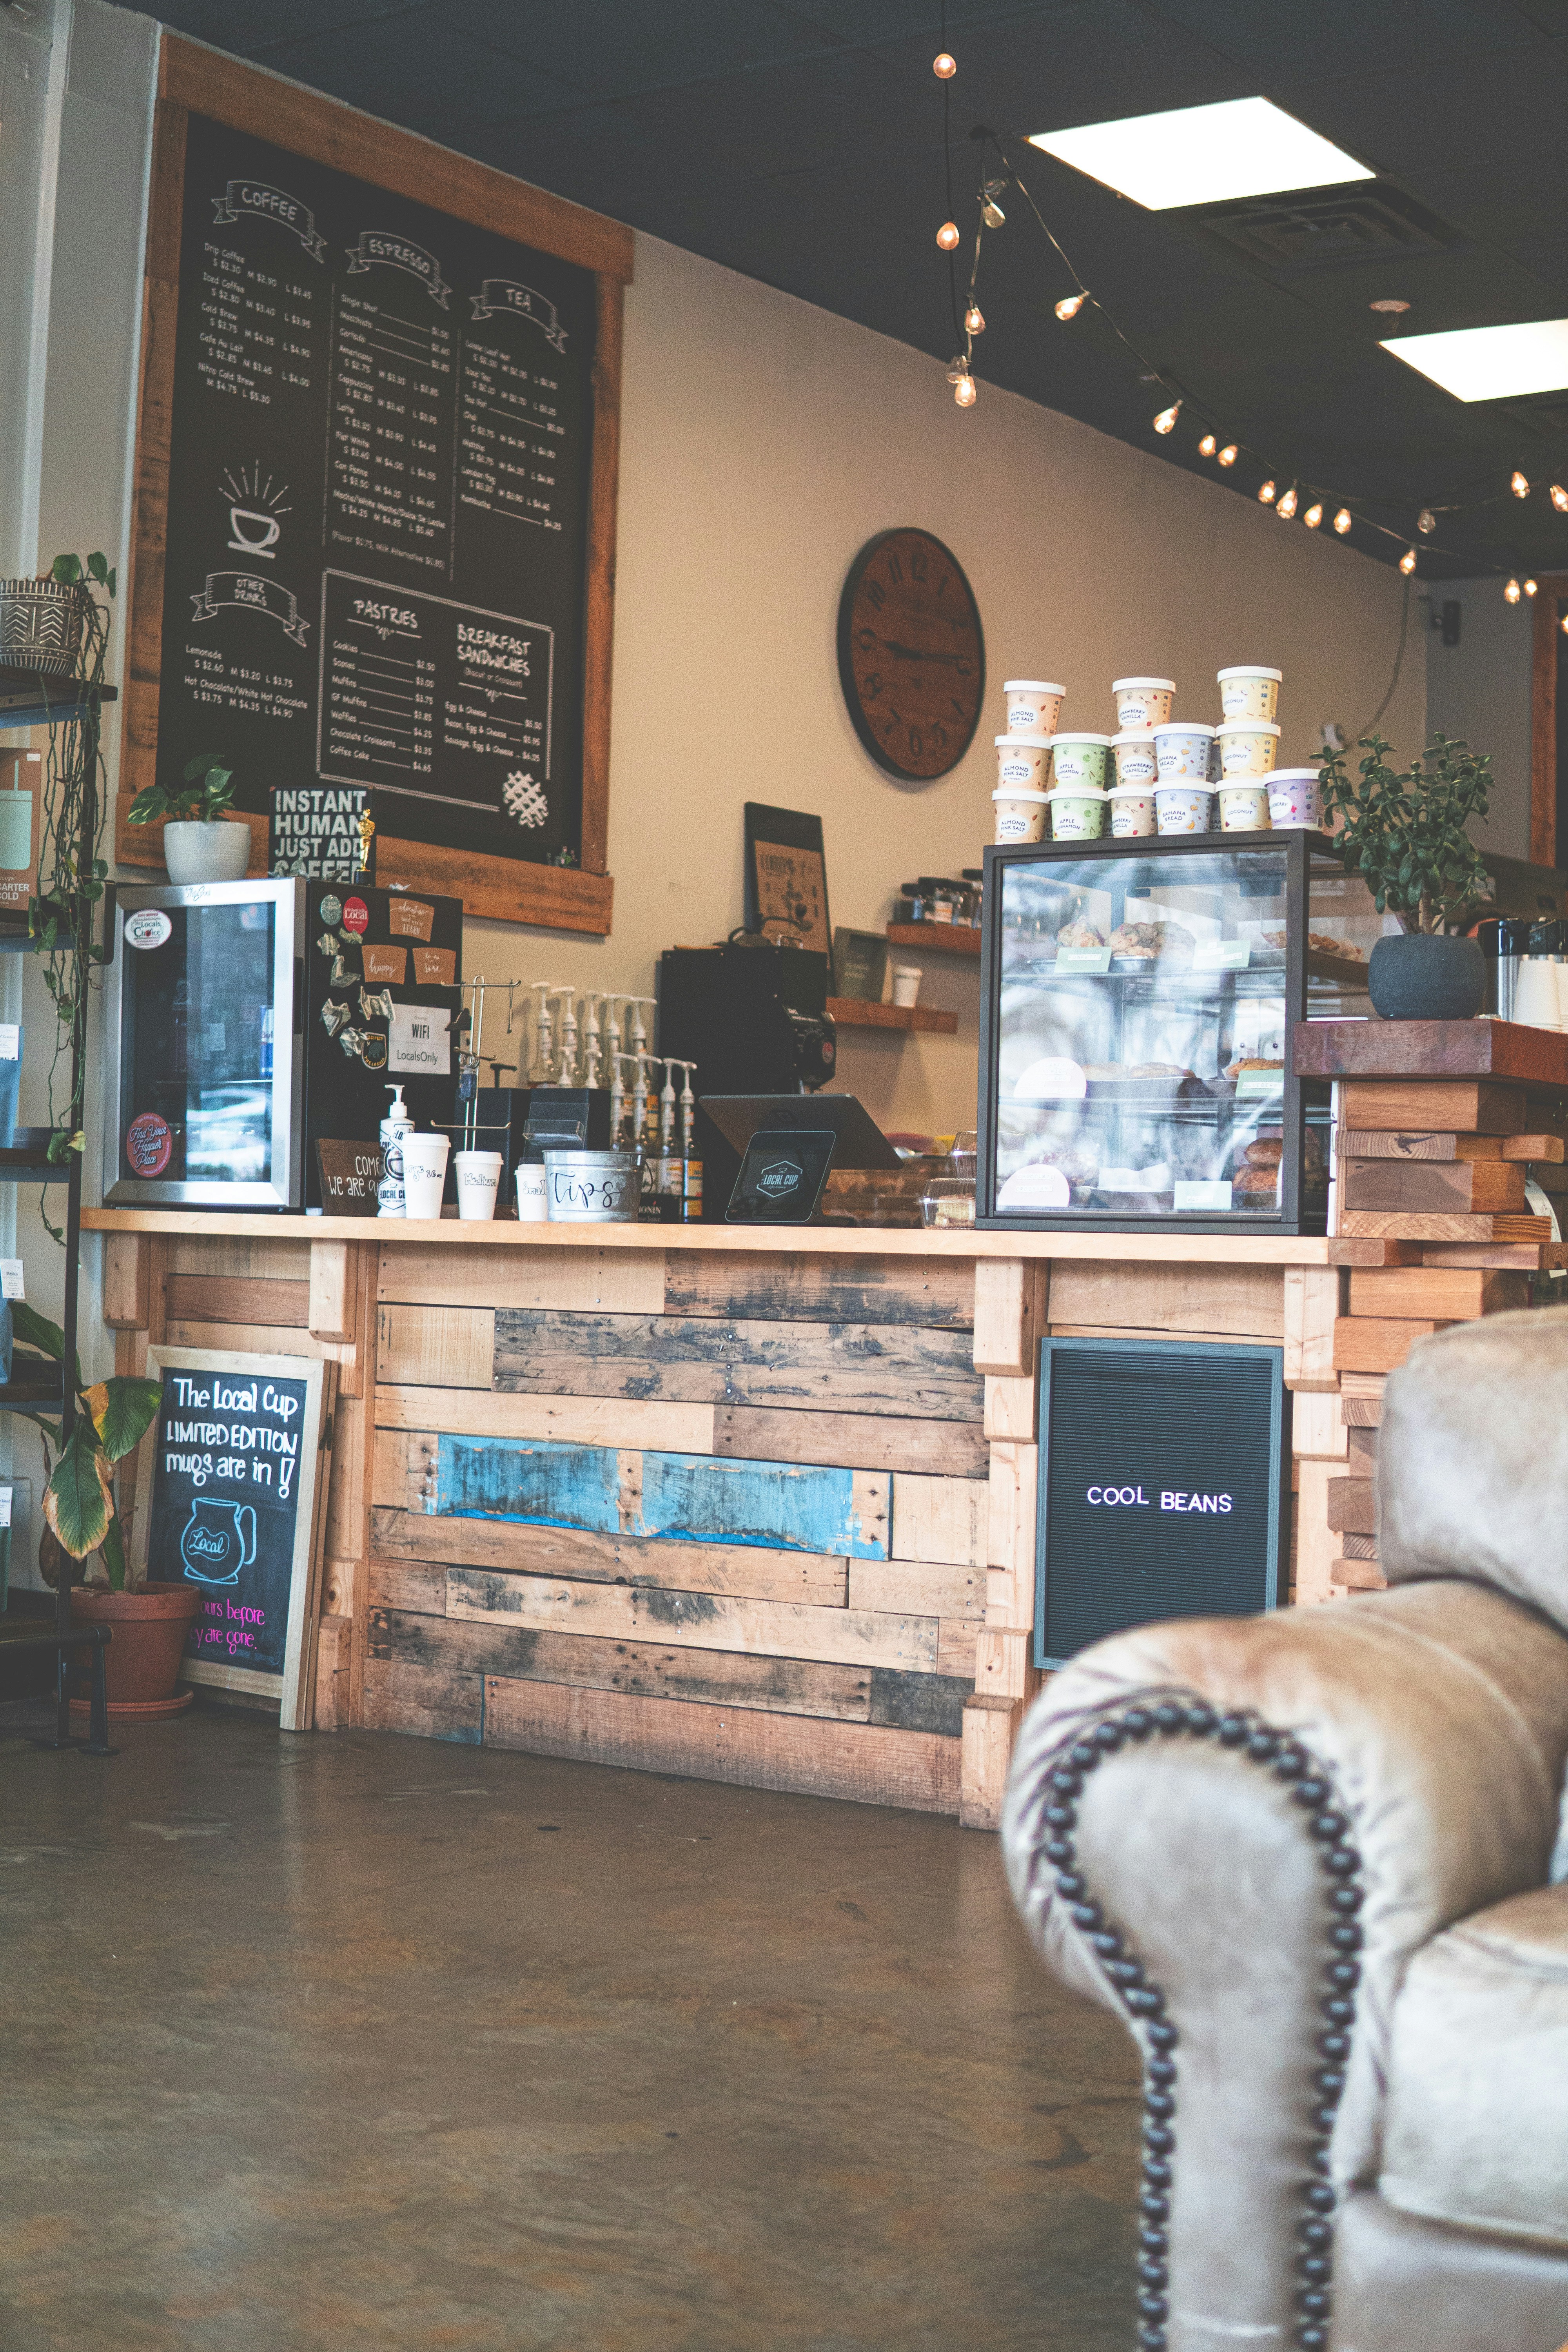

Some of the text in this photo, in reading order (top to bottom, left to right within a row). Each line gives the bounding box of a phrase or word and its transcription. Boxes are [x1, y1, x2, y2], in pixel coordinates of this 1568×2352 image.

[241, 187, 298, 221] COFFEE
[204, 242, 245, 264] Drip Coffee
[369, 239, 430, 274] ESPRESSO
[203, 272, 245, 294] Iced Coffee
[201, 302, 238, 321] Cold Brew
[198, 362, 255, 387] Nitro Cold Brew
[237, 578, 265, 594] OTHER
[235, 589, 267, 606] DRINKS
[353, 600, 418, 628] PASTRIES
[332, 640, 358, 653] Cookies
[457, 623, 532, 655] BREAKFAST
[185, 644, 222, 660] Lemonade
[457, 645, 531, 676] SANDWICHES
[194, 659, 200, 668] S
[230, 667, 238, 676] M
[265, 675, 271, 684] L
[332, 657, 356, 670] Scones
[331, 675, 357, 688] Muffins
[184, 675, 198, 686] Hot
[260, 692, 273, 701] Hot
[275, 695, 308, 710] Chocolate
[341, 695, 367, 708] Muffins
[330, 710, 357, 723] Waffles
[330, 727, 361, 741] Chocolate
[329, 745, 352, 757] Coffee
[353, 750, 370, 761] Cake
[275, 790, 367, 813] INSTANT
[275, 814, 364, 835] HUMAN
[275, 838, 361, 857] JUST ADD
[0, 883, 29, 891] ARTER
[0, 892, 19, 900] OLD
[345, 909, 367, 920] Local
[369, 953, 398, 977] happy
[412, 1024, 430, 1039] WIFI
[397, 1049, 438, 1065] LocalsOnly
[129, 1124, 167, 1142] Find Your
[133, 1138, 162, 1156] Happier
[135, 1153, 156, 1168] Place
[404, 1165, 424, 1181] arge
[464, 1173, 497, 1187] Medium
[763, 1174, 799, 1185] LOCAL CUP
[381, 1190, 397, 1199] LOCAL
[523, 1179, 547, 1195] Small
[550, 1171, 622, 1209] Tips
[173, 1378, 298, 1423] The Local Cup
[231, 1424, 298, 1455] EDITION
[167, 1453, 213, 1486] mugs
[217, 1456, 246, 1479] are
[253, 1457, 272, 1485] in
[1087, 1486, 1232, 1513] COOL BEANS
[189, 1531, 225, 1553] Local
[200, 1599, 265, 1628] ours before
[190, 1627, 257, 1654] ey are gone.
